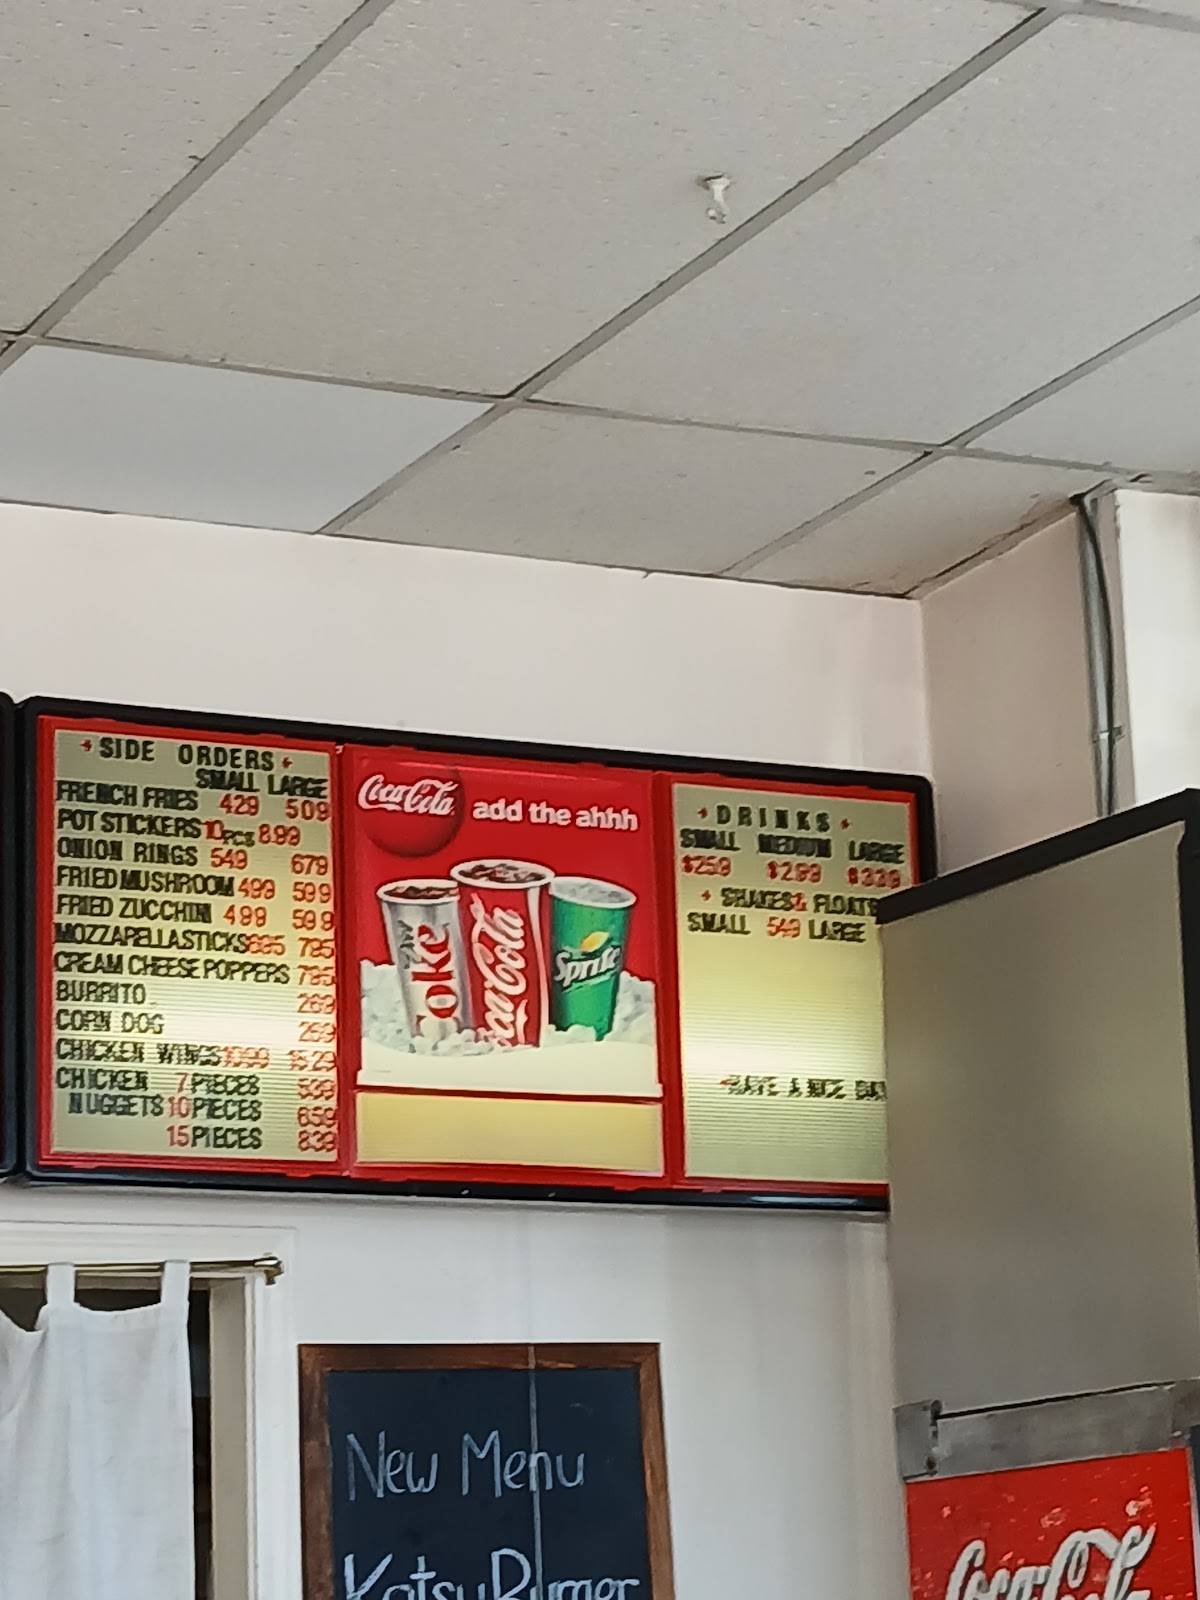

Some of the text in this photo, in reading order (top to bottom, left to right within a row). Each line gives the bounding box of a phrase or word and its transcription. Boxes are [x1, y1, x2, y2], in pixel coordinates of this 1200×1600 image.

[99, 737, 274, 771] SIDE ORDERS
[57, 780, 140, 806] FRENCH
[143, 788, 199, 811] FRIES
[195, 768, 328, 798] SMALL LARGE
[58, 809, 94, 830] POT
[102, 812, 203, 838] STICKERS
[473, 798, 638, 831] add the ahhh
[717, 805, 830, 832] DRINKS
[57, 837, 123, 860] ONION
[134, 841, 198, 866] RINGS
[680, 828, 905, 864] SMALL MEDIUM LARGE
[57, 866, 117, 888] FRIED
[120, 869, 236, 897] MUSHROOM
[56, 894, 113, 917] FRIED
[687, 912, 751, 935] SMALL
[809, 919, 866, 943] LARGE
[54, 951, 123, 975] CREAM
[128, 955, 202, 980] CHEESE
[203, 958, 290, 984] POPPERS
[555, 945, 620, 988] Sprite
[55, 980, 146, 1004] BURRITO
[55, 1009, 112, 1031] CORN
[121, 1012, 165, 1035] DOG
[55, 1038, 145, 1063] CHICKEN
[55, 1067, 149, 1091] CHICKEN
[68, 1092, 165, 1117] NUGGETS
[346, 1430, 585, 1501] New Menu
